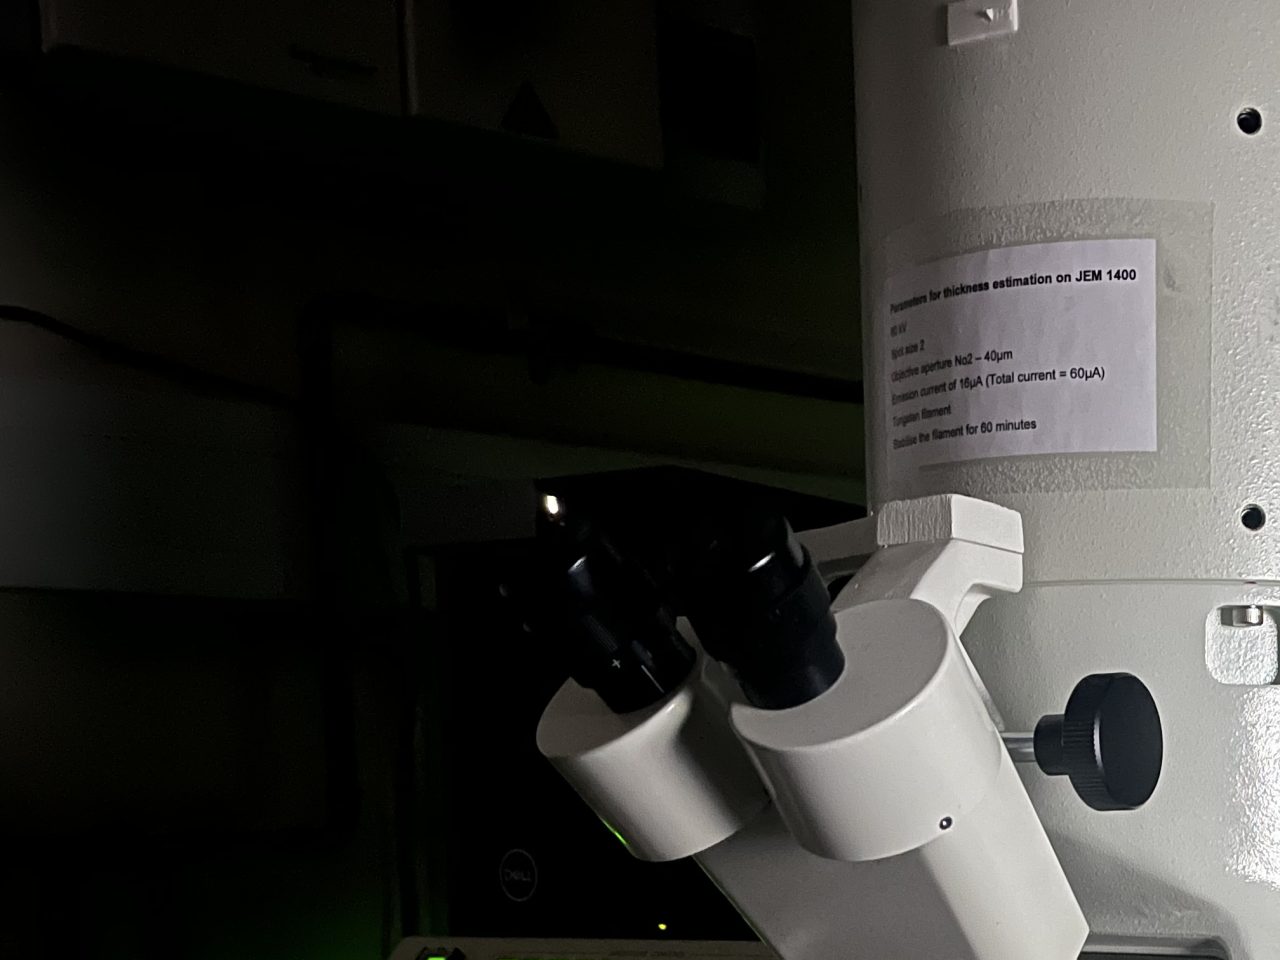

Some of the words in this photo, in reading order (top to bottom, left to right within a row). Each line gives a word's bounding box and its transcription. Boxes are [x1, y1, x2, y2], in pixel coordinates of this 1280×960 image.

[943, 282, 989, 298] thickness
[992, 272, 1052, 289] estimation
[1075, 269, 1102, 282] JEM
[1106, 269, 1137, 281] 1400
[921, 358, 952, 375] aperture
[920, 382, 946, 397] current
[986, 371, 1014, 388] (Total
[1017, 369, 1056, 382] current
[922, 404, 951, 419] filament
[932, 427, 963, 440] filament
[996, 419, 1036, 432] minutes
